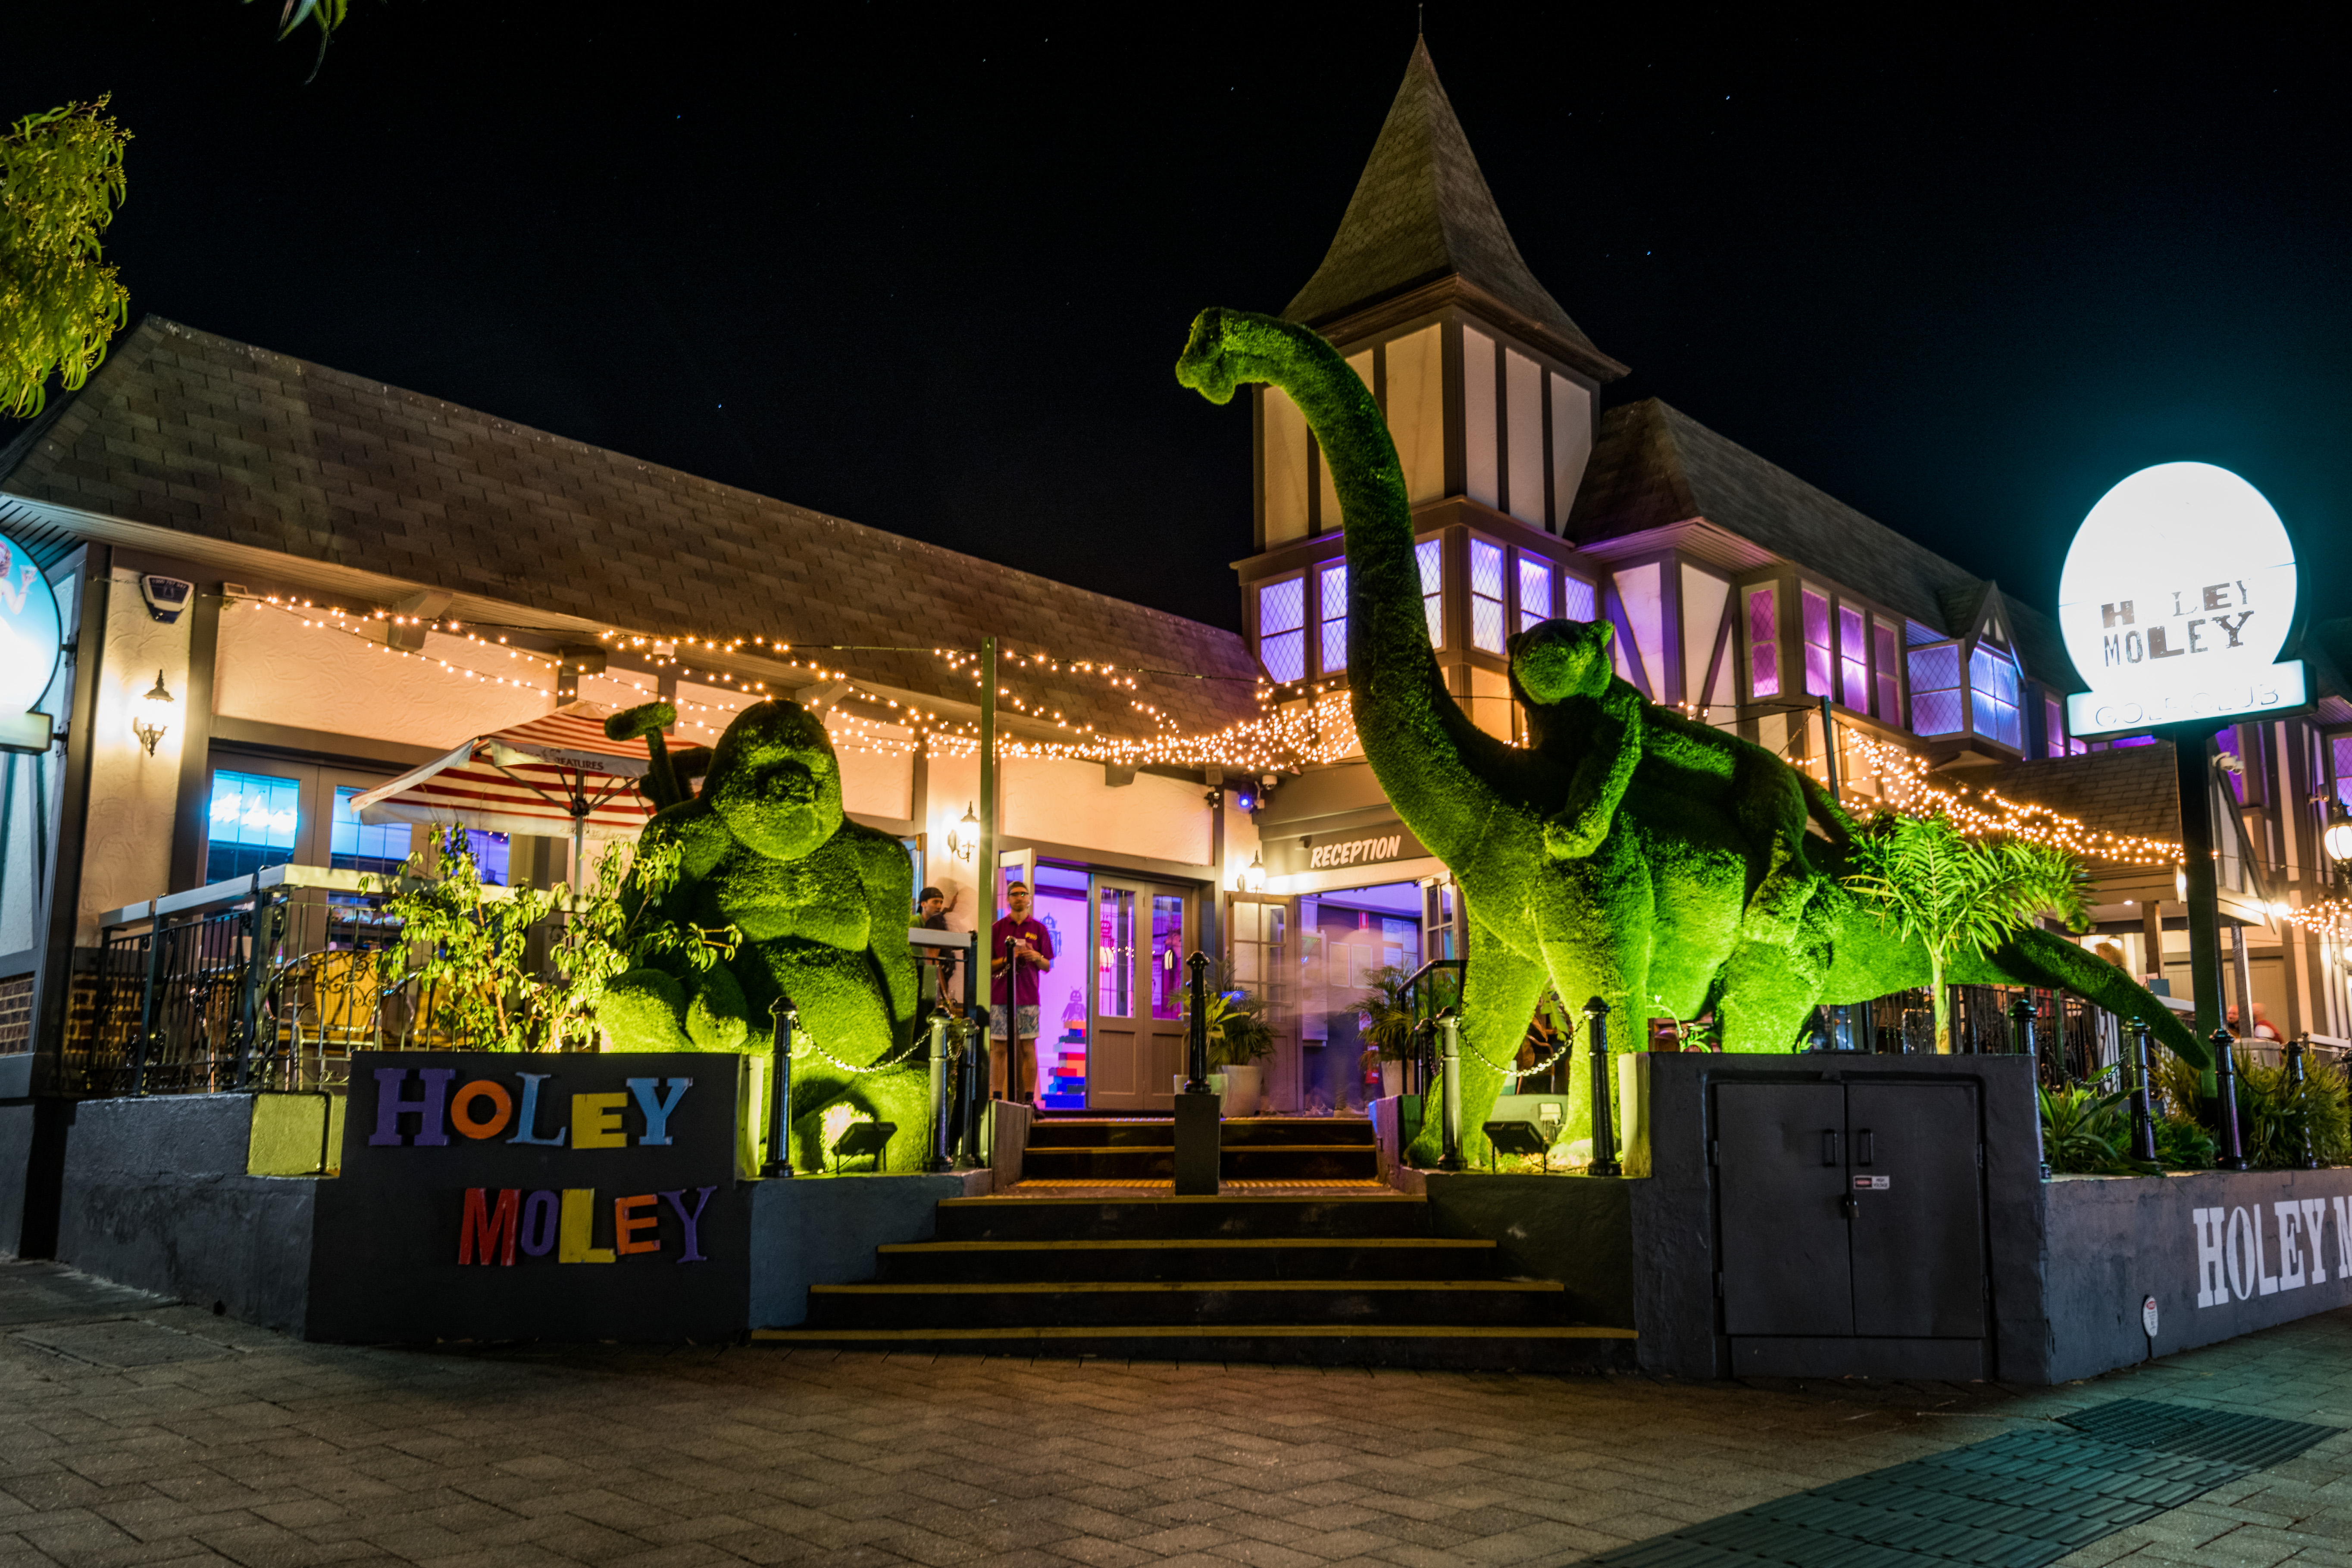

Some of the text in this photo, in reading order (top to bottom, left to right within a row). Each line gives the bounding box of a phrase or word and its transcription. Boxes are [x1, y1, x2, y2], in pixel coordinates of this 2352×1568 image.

[2101, 578, 2251, 629] HLEY
[2104, 610, 2254, 667] MOLEY
[1310, 835, 1401, 869] RECEPTION
[369, 1068, 693, 1150] HOLEY
[457, 1186, 717, 1267] MOLEY
[2193, 1198, 2326, 1308] HOLEY
